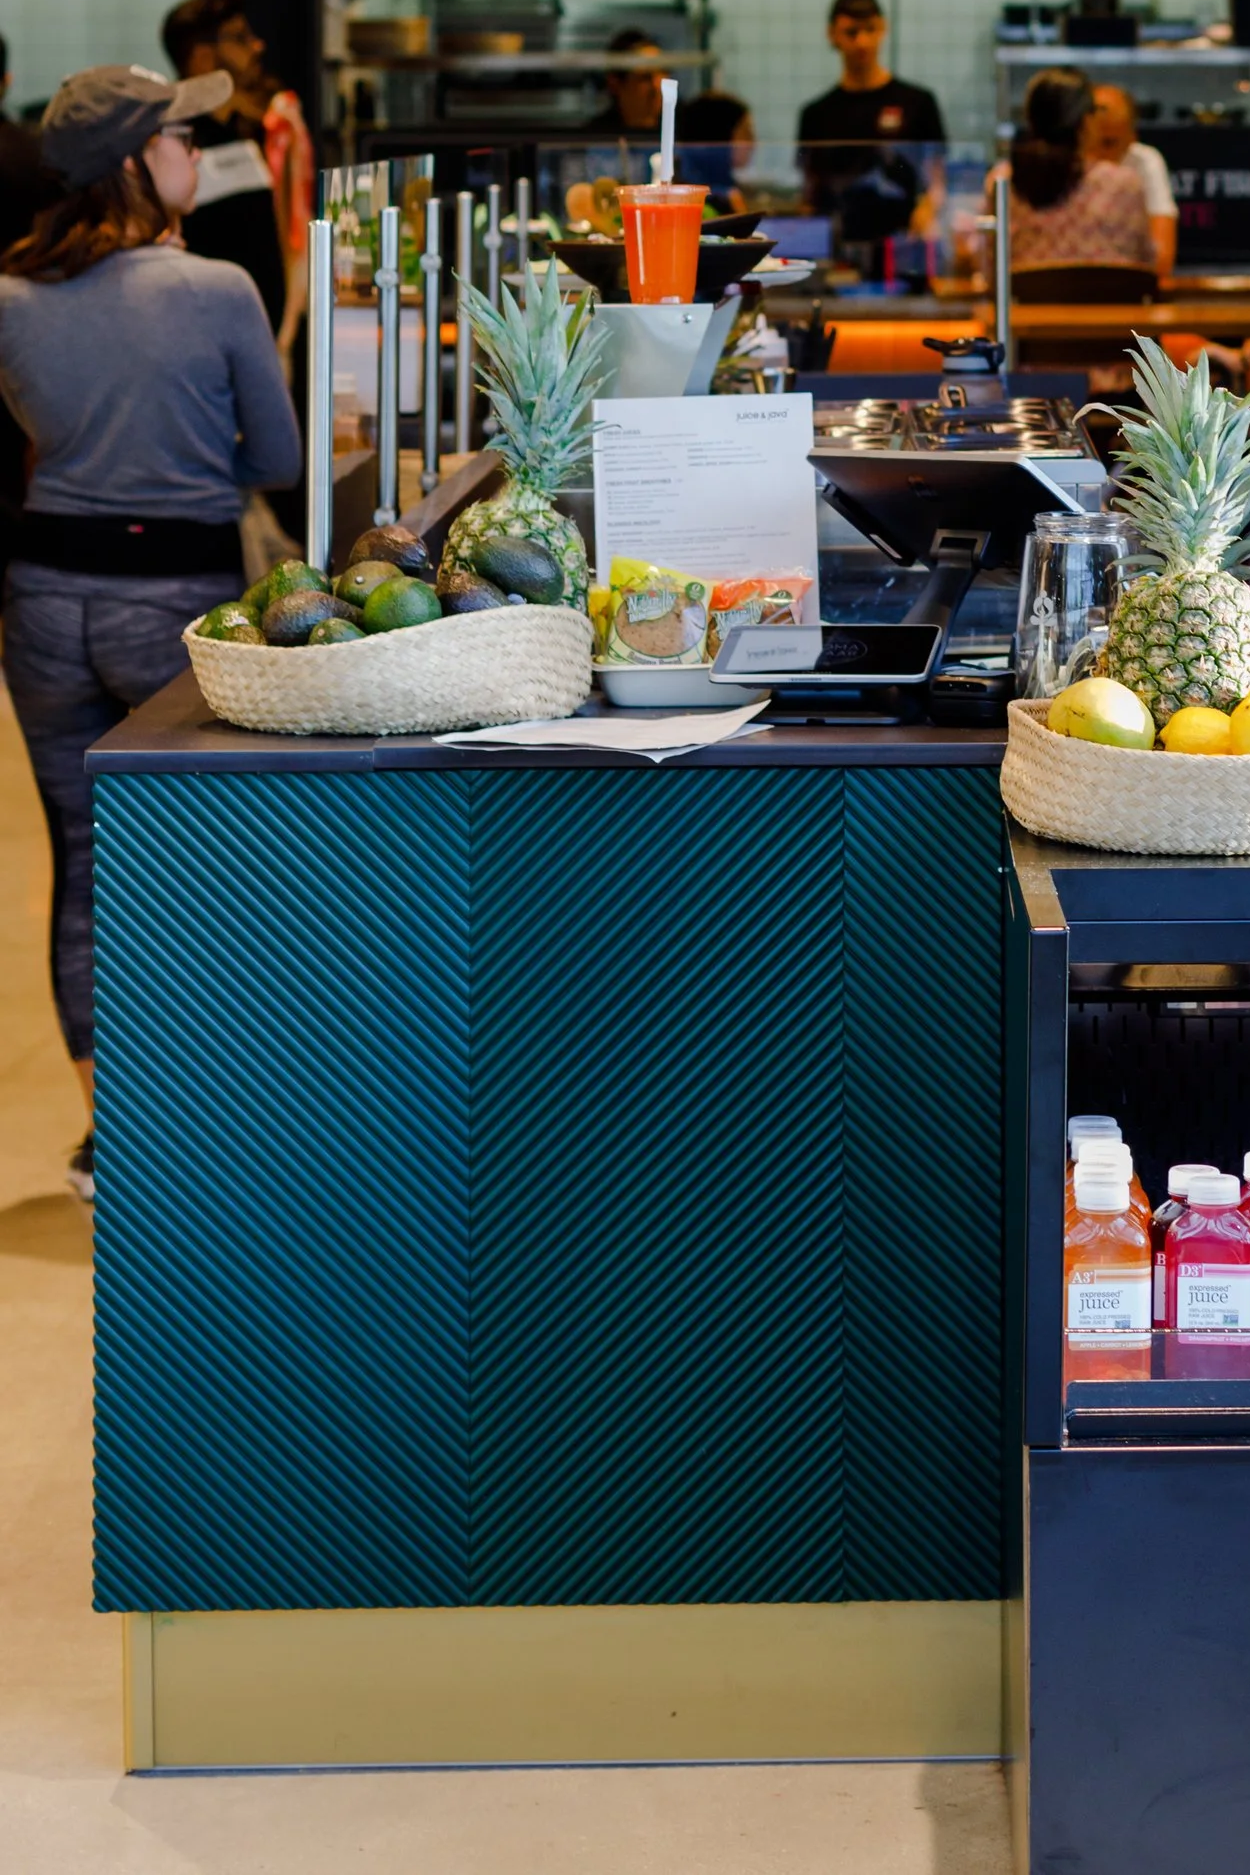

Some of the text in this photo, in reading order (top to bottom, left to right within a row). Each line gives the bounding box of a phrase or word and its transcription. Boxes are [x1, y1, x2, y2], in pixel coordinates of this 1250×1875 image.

[736, 411, 759, 422] juice
[767, 410, 788, 421] java
[1078, 1297, 1121, 1313] juice
[1188, 1291, 1229, 1306] juice
